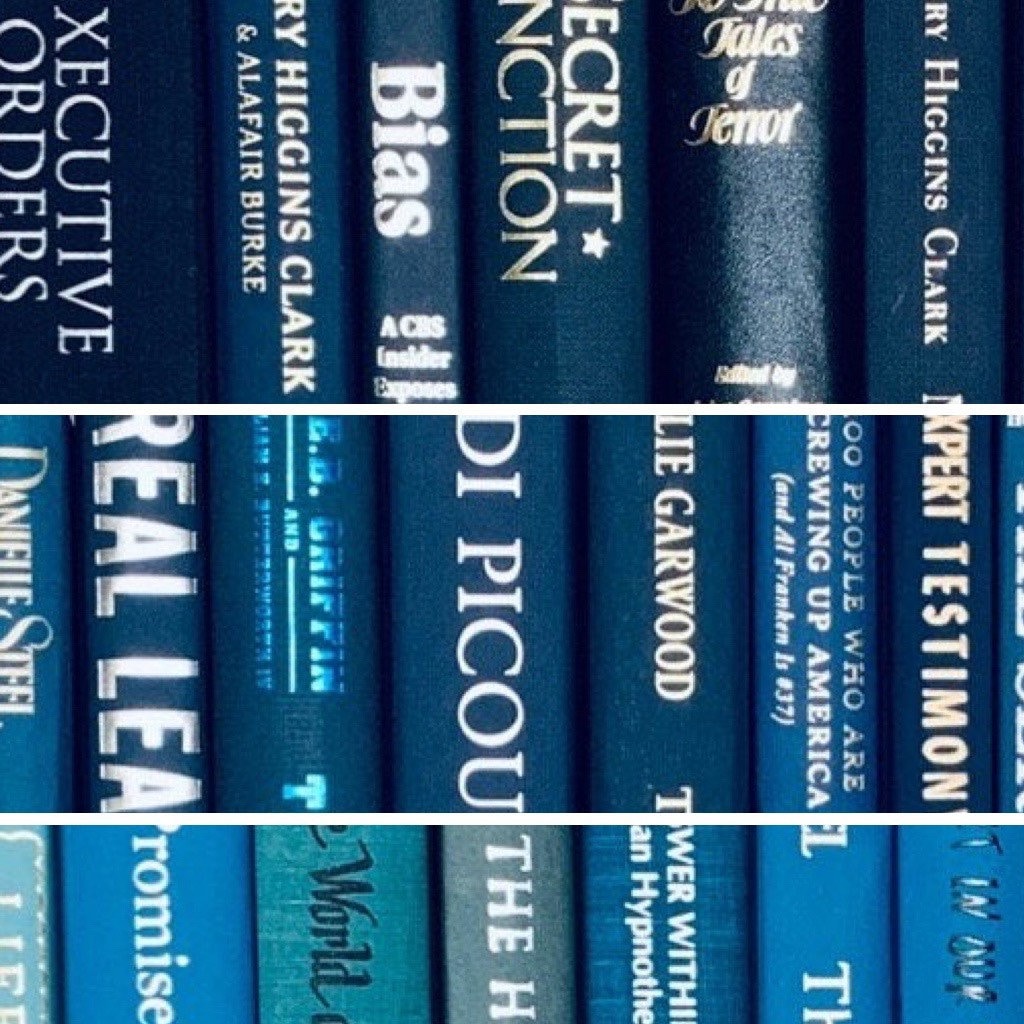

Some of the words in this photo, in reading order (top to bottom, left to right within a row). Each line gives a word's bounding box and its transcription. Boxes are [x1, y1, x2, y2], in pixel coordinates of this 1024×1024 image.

[236, 24, 258, 43] &
[700, 17, 804, 60] Tales
[724, 60, 758, 100] of
[0, 18, 48, 302] ORDERS
[237, 52, 265, 182] ALAFAIR
[275, 60, 312, 243] HIGGINS
[371, 61, 449, 239] Bias
[496, 0, 558, 283] NCTION
[561, 0, 623, 224] ECRET
[684, 102, 802, 147] Terror
[923, 58, 960, 212] HIGGINS
[55, 6, 114, 355] XECUTIVE
[242, 189, 267, 293] BURKE
[279, 256, 316, 394] CLARK
[923, 226, 960, 345] CLARK
[92, 415, 200, 618] REAL
[283, 508, 301, 552] AND
[805, 415, 832, 573] CREWING
[843, 483, 865, 613] PEOPLE
[653, 489, 697, 702] GARWOOD
[774, 559, 796, 647] Franken
[806, 586, 832, 632] UP
[456, 537, 525, 813] PICOU
[806, 643, 832, 809] AMERICA
[843, 628, 866, 712] WHO
[920, 541, 970, 813] TESTIMON
[843, 724, 866, 793] ARE
[308, 841, 379, 1008] World
[486, 834, 534, 955] THE
[949, 875, 1002, 922] IN
[945, 934, 998, 1005] OUR
